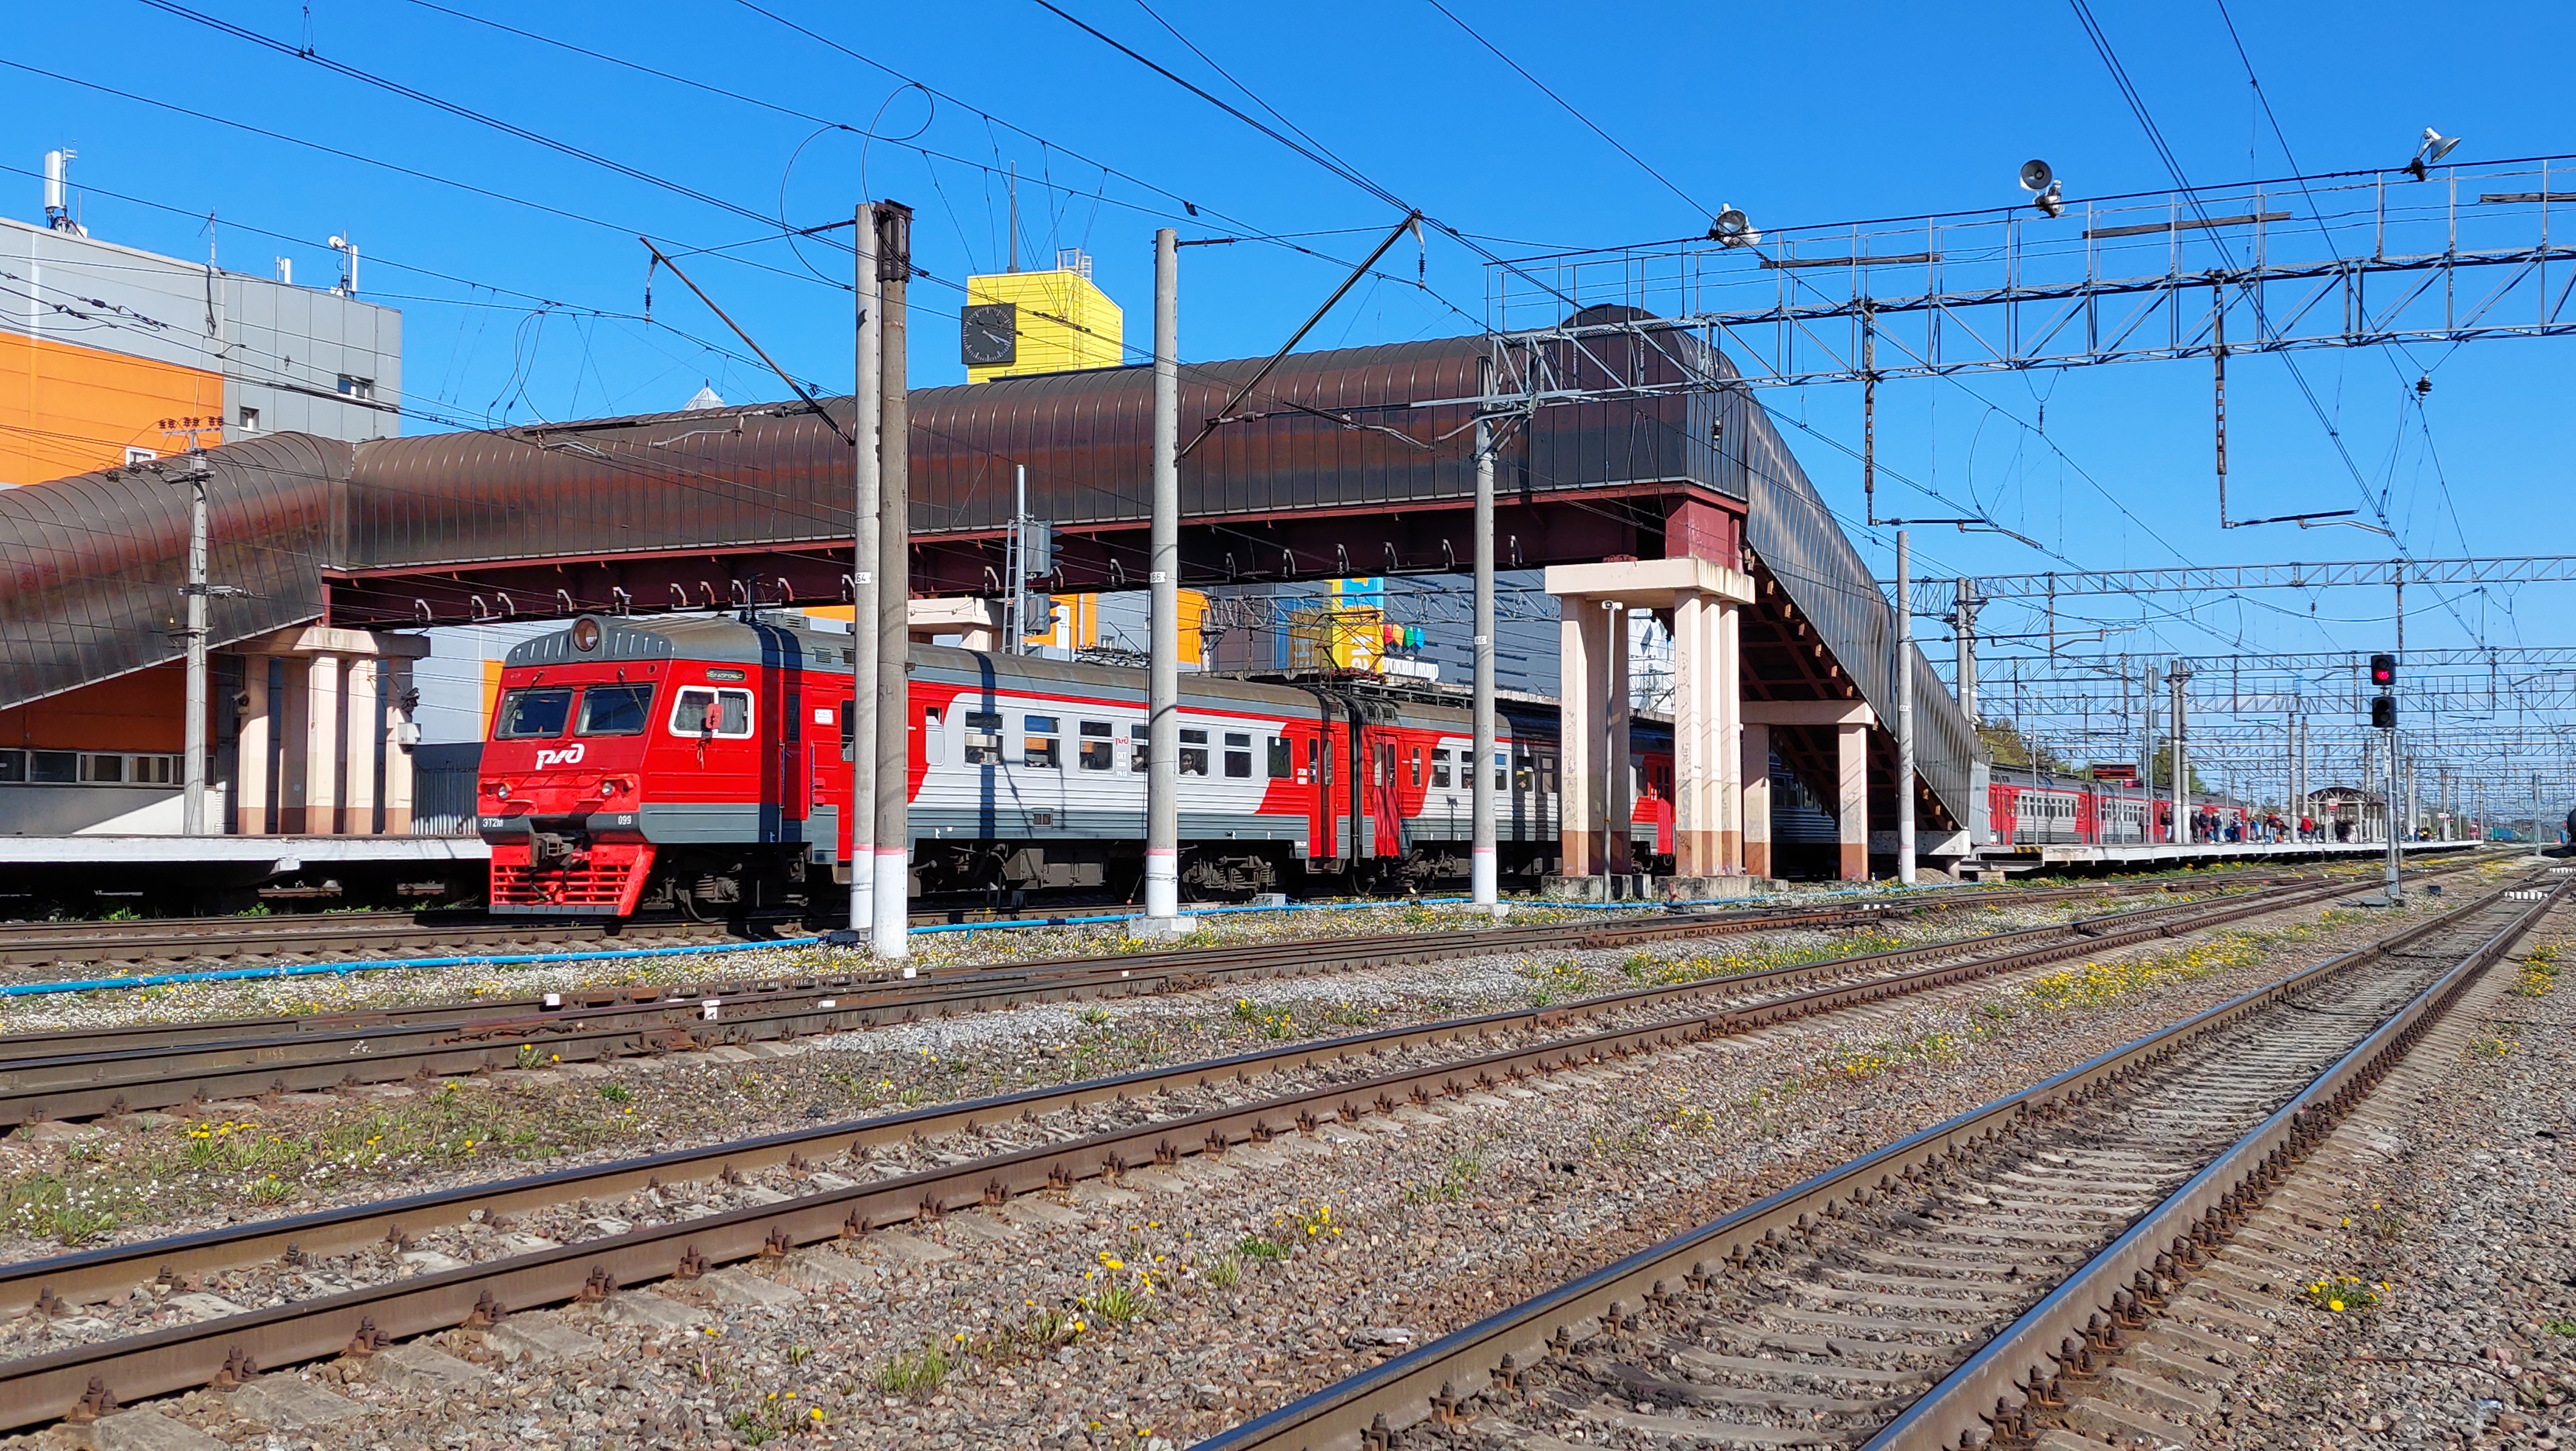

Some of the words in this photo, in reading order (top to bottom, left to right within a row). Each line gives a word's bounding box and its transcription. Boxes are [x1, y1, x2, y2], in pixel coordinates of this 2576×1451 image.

[856, 573, 866, 582] 64
[535, 743, 585, 770] РЖД
[618, 815, 632, 825] 099
